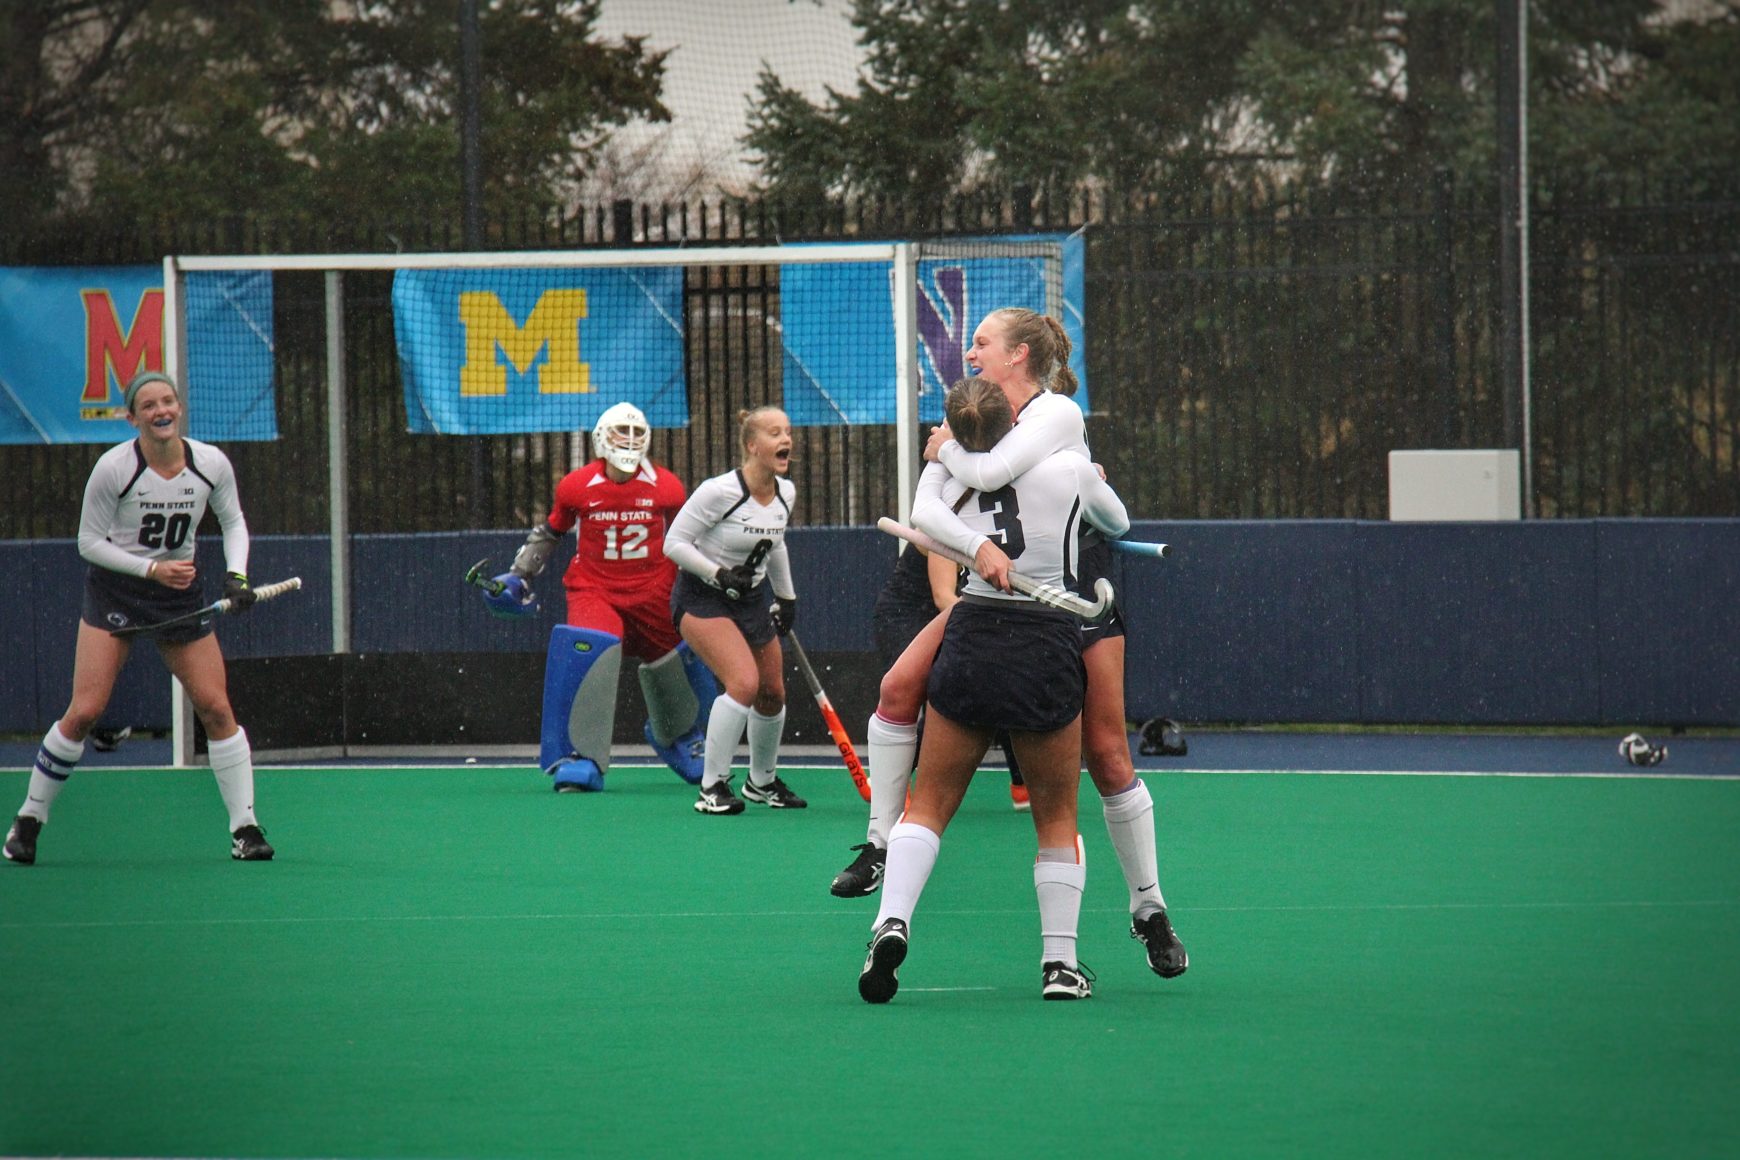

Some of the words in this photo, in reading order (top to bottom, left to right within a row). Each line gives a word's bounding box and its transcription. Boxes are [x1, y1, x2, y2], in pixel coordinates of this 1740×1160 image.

[80, 288, 165, 402] M
[459, 288, 590, 397] M
[140, 501, 166, 510] PENN
[167, 501, 196, 510] STATE
[589, 511, 618, 521] PENN
[620, 511, 653, 521] STATE
[978, 484, 1026, 560] 3
[138, 513, 192, 550] 20
[604, 524, 649, 560] 12
[743, 526, 765, 535] PENN
